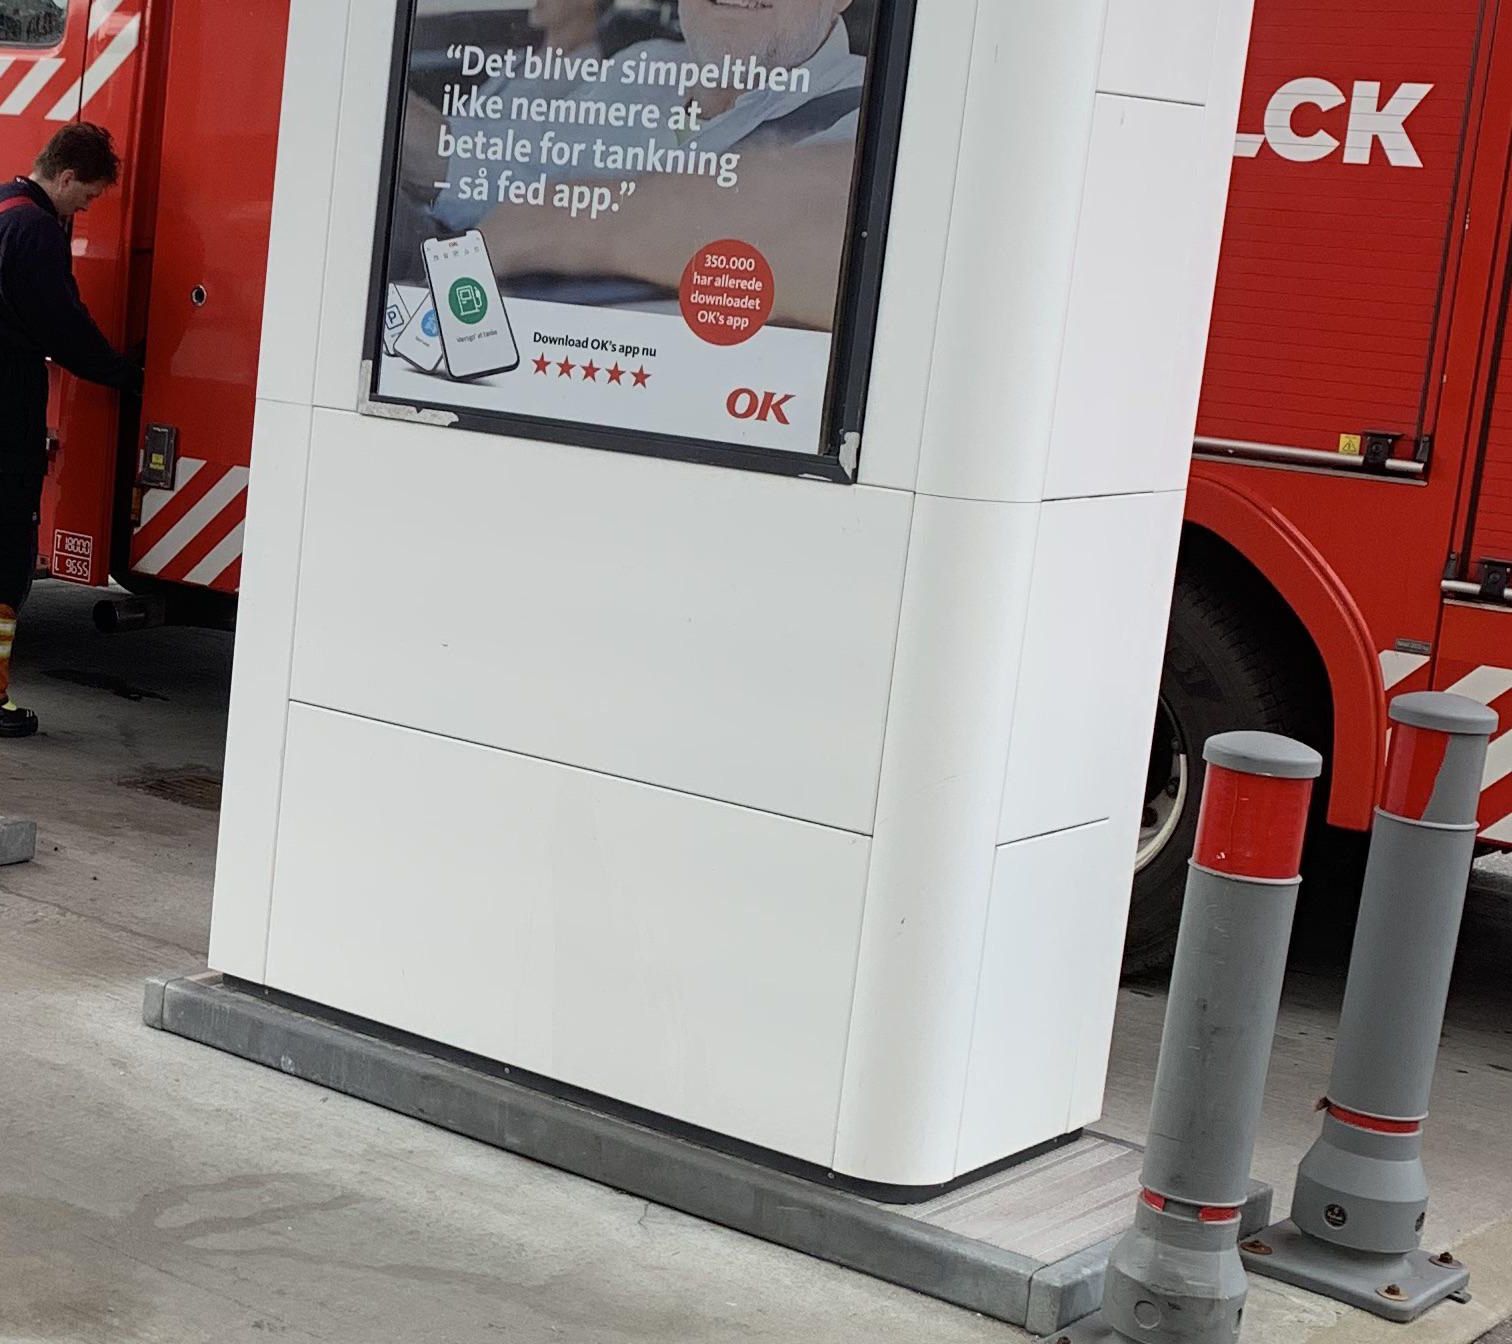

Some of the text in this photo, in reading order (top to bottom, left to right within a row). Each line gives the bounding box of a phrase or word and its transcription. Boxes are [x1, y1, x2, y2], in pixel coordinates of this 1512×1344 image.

[446, 44, 810, 95] “Det bliver simpelthen
[442, 84, 702, 131] ikke nemmere at
[1233, 76, 1435, 168] CK
[437, 124, 741, 187] betale for tankning
[457, 168, 489, 201] så
[496, 170, 547, 206] fed
[704, 254, 756, 271] 350.000
[693, 271, 763, 291] har allerede
[690, 290, 761, 310] downloadet
[386, 309, 398, 325] P
[697, 310, 750, 331] OK’s app
[533, 331, 657, 358] Download OK’s app nu
[726, 387, 796, 425] OK
[56, 534, 91, 555] T 18000
[54, 557, 89, 576] L 9655
